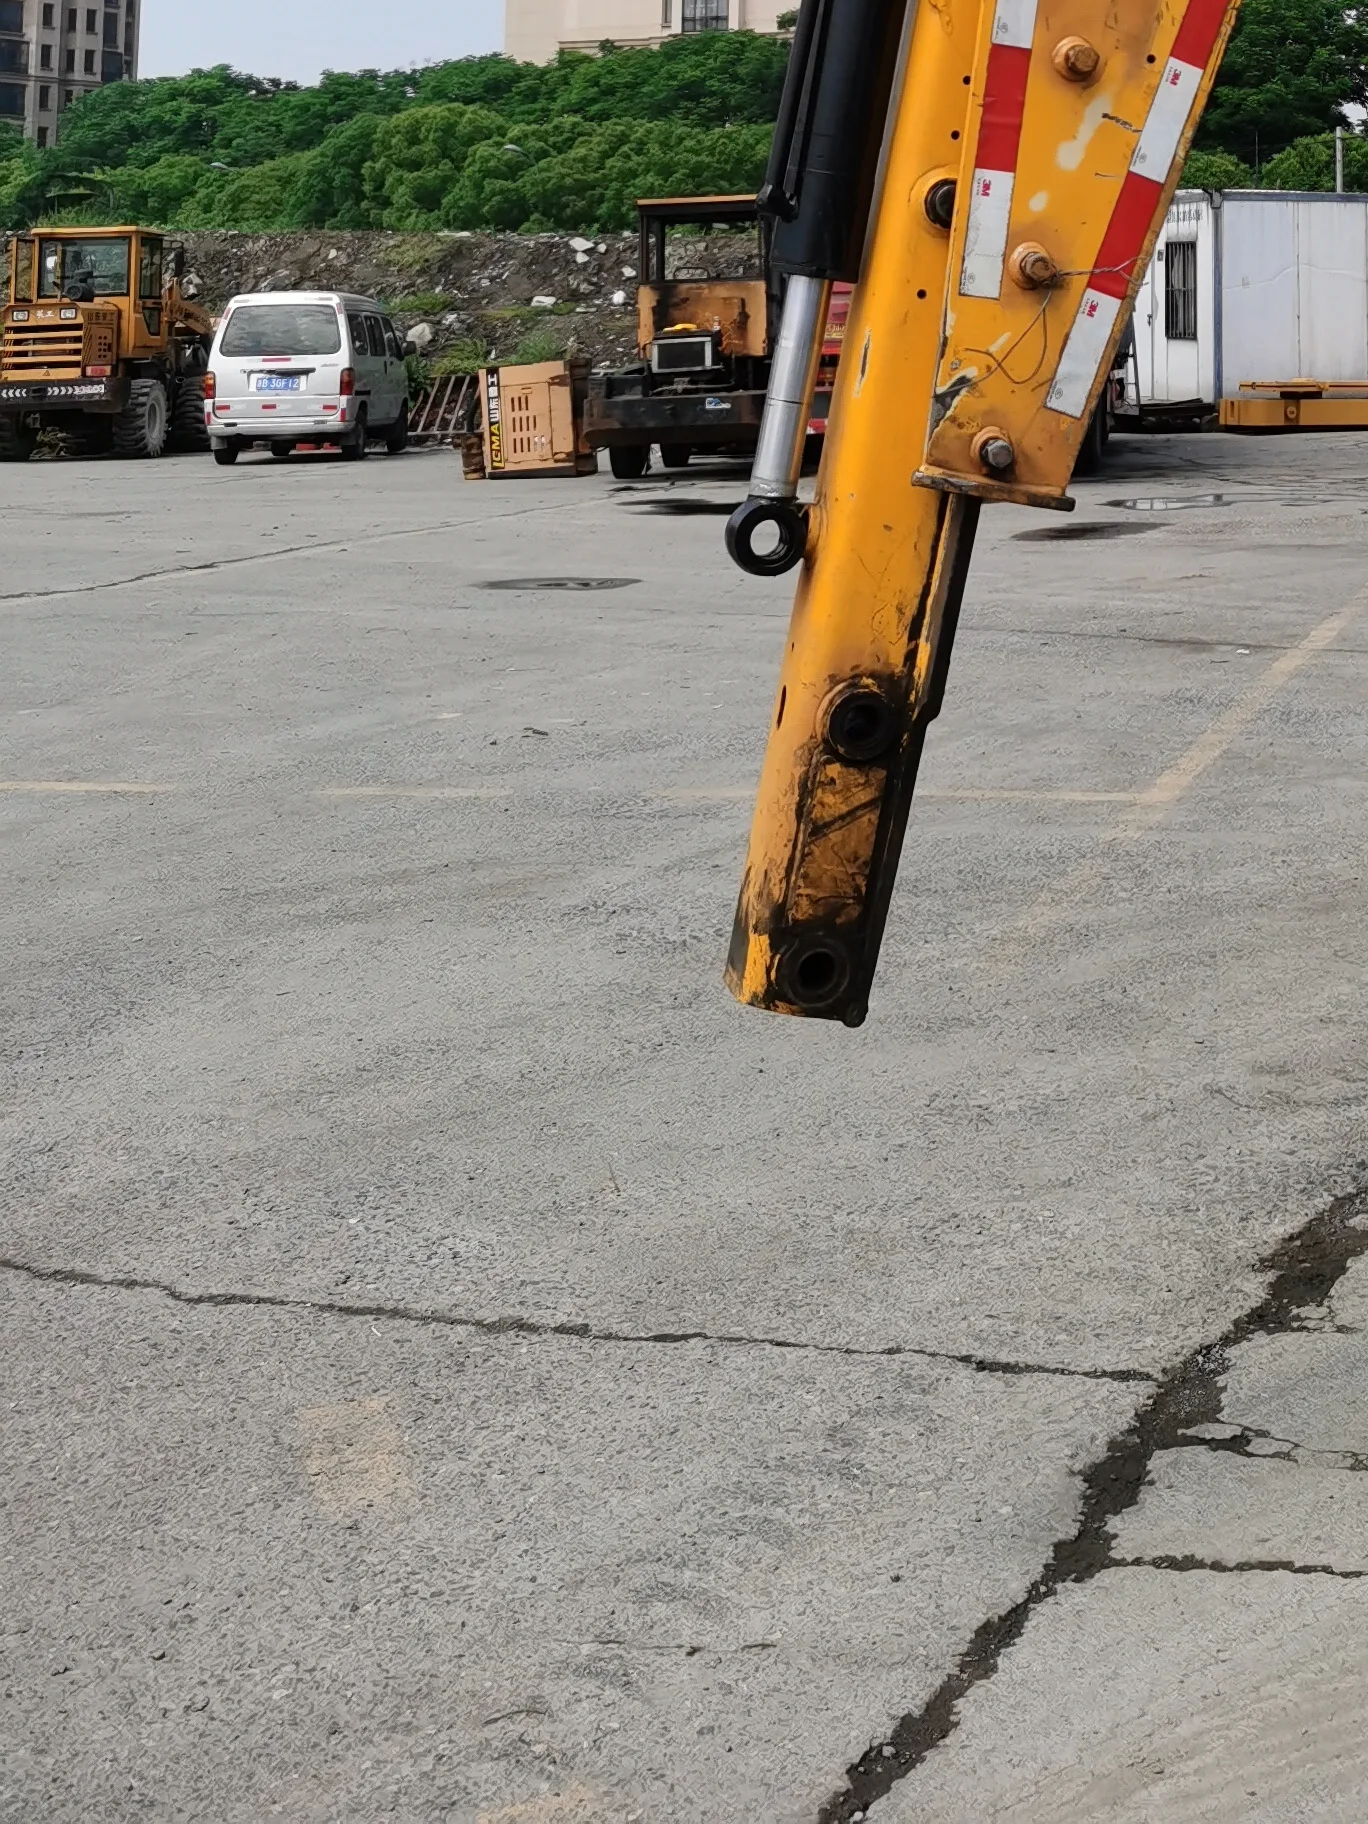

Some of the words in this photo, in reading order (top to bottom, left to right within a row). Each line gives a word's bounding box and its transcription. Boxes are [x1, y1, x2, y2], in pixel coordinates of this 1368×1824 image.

[1170, 68, 1181, 86] 3M
[981, 179, 991, 197] 3M
[1087, 300, 1099, 318] 3M
